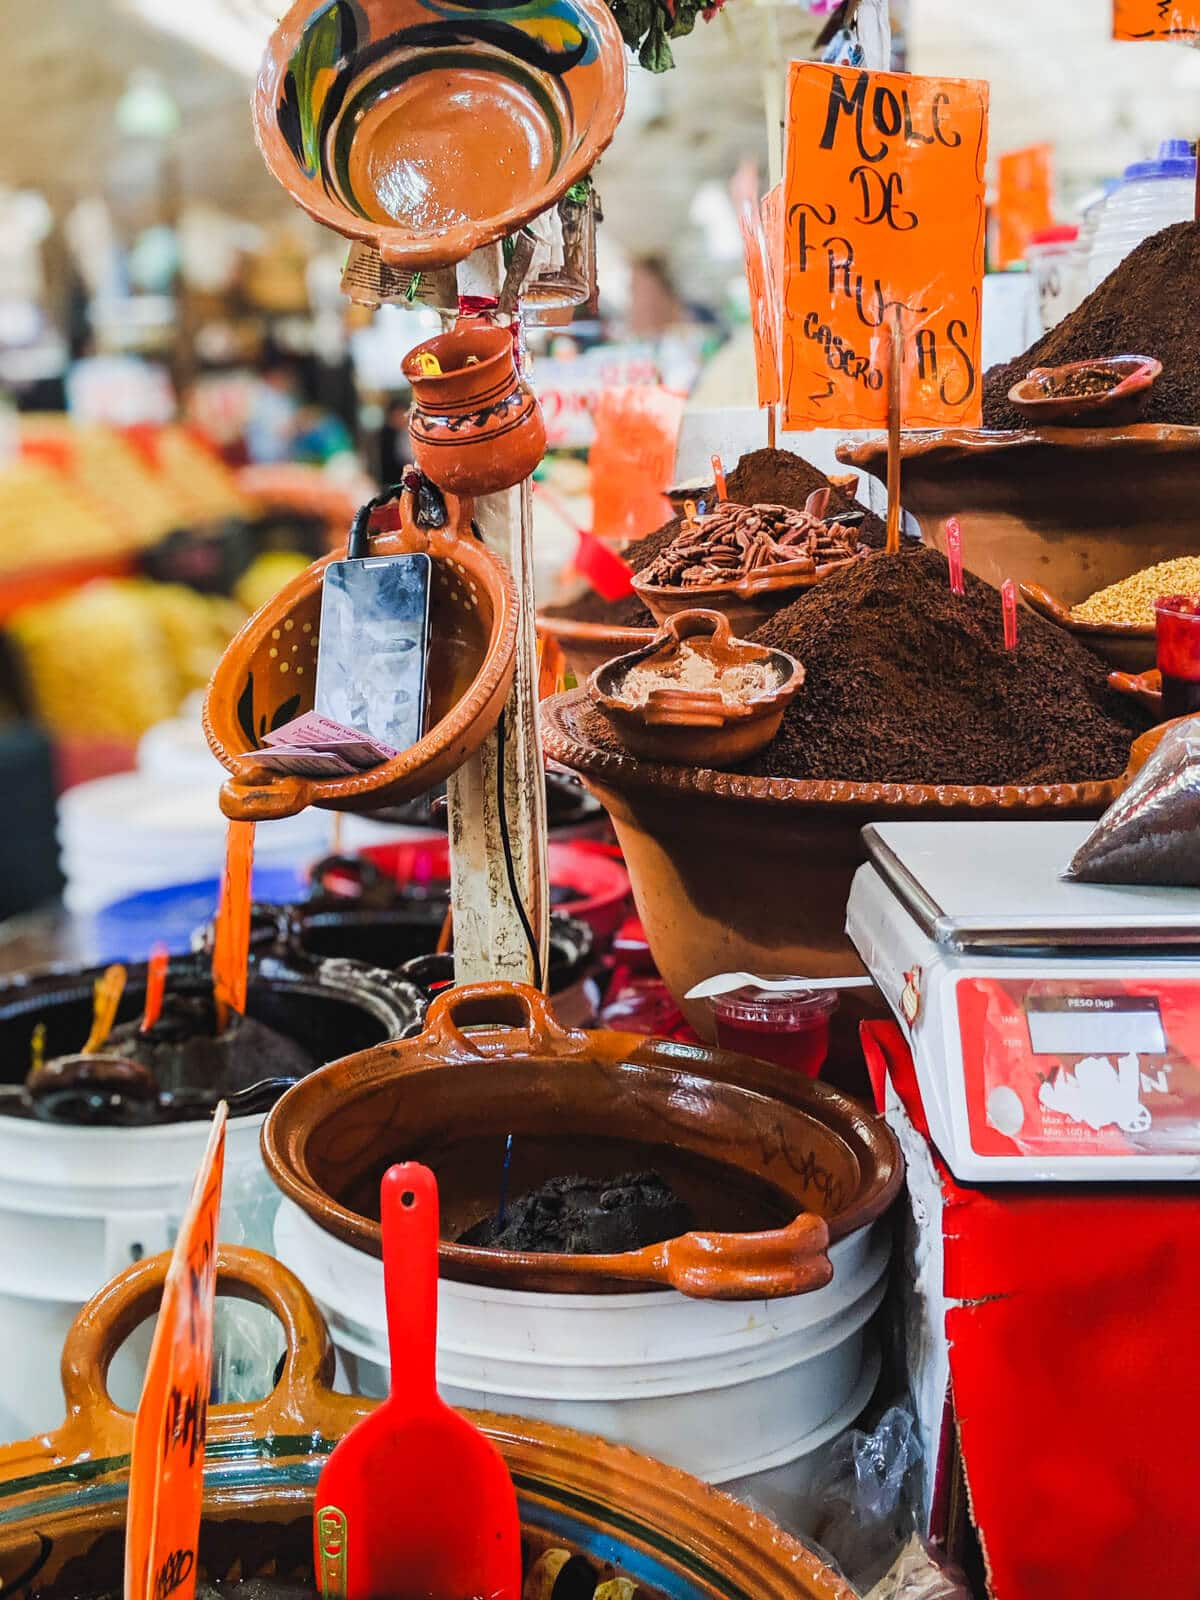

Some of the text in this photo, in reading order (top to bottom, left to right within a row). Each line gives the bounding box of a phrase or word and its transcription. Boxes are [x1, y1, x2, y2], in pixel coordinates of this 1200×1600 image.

[849, 165, 918, 230] DE
[789, 203, 975, 405] FRUTAS
[1068, 998, 1114, 1009] PESO (kg)
